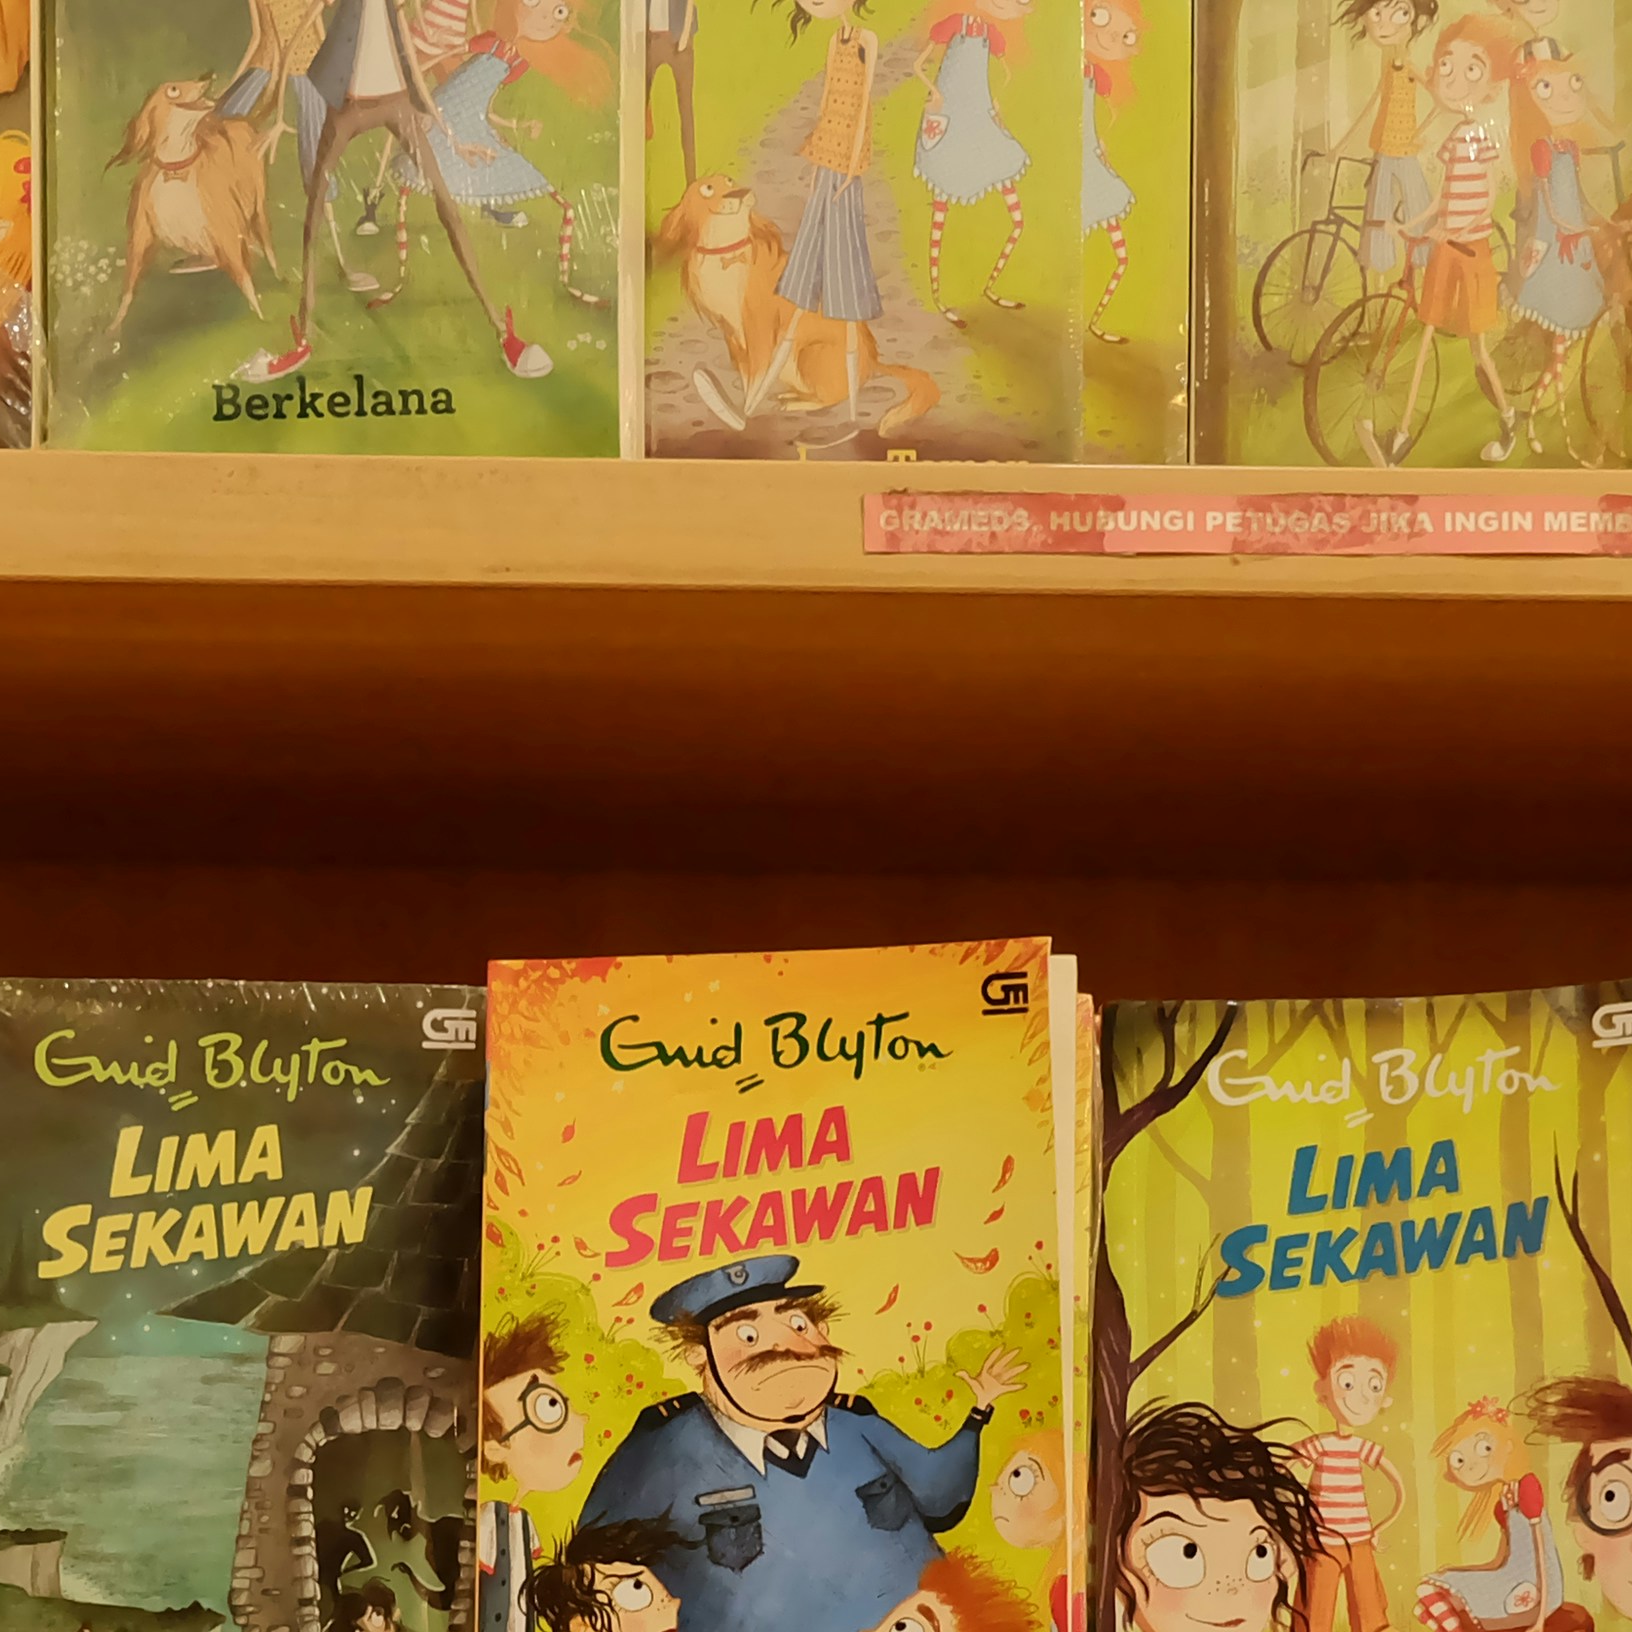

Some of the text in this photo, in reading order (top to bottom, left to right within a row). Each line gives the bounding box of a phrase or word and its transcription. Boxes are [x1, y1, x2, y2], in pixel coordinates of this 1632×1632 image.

[211, 374, 455, 423] Berkelana
[1050, 510, 1194, 532] HUBUNGI
[1206, 510, 1350, 534] PETUGAS
[1361, 511, 1434, 534] JIKA
[1444, 510, 1533, 533] INGIN
[34, 1029, 390, 1102] Enid Blyton
[600, 1011, 954, 1080] Enid Blyton
[1207, 1047, 1563, 1114] Enid Blyton
[110, 1123, 283, 1198] LIMA
[677, 1105, 851, 1184] LIMA
[1287, 1139, 1459, 1215] LIMA
[38, 1186, 373, 1279] SEKAWAN
[604, 1166, 941, 1268] SEKAWAN
[1214, 1196, 1549, 1298] SEKAWAN
